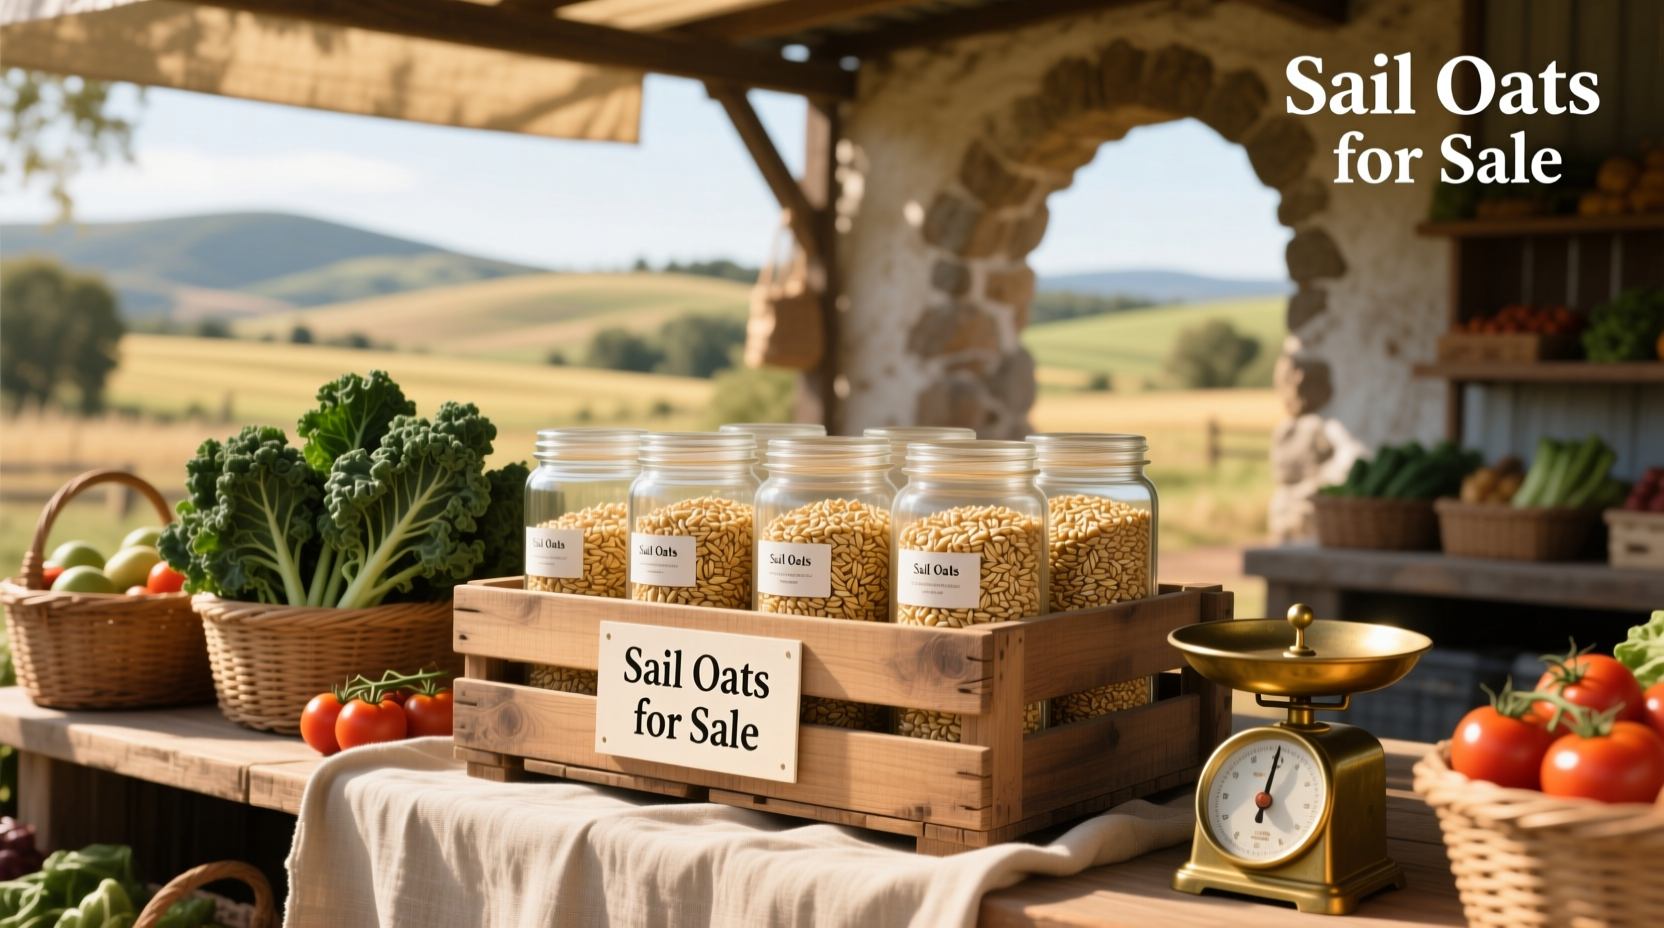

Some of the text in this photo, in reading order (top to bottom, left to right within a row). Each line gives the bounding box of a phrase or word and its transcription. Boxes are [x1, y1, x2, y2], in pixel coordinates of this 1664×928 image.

[623, 646, 770, 699] Sail Oats
[633, 697, 759, 752] for Sale
